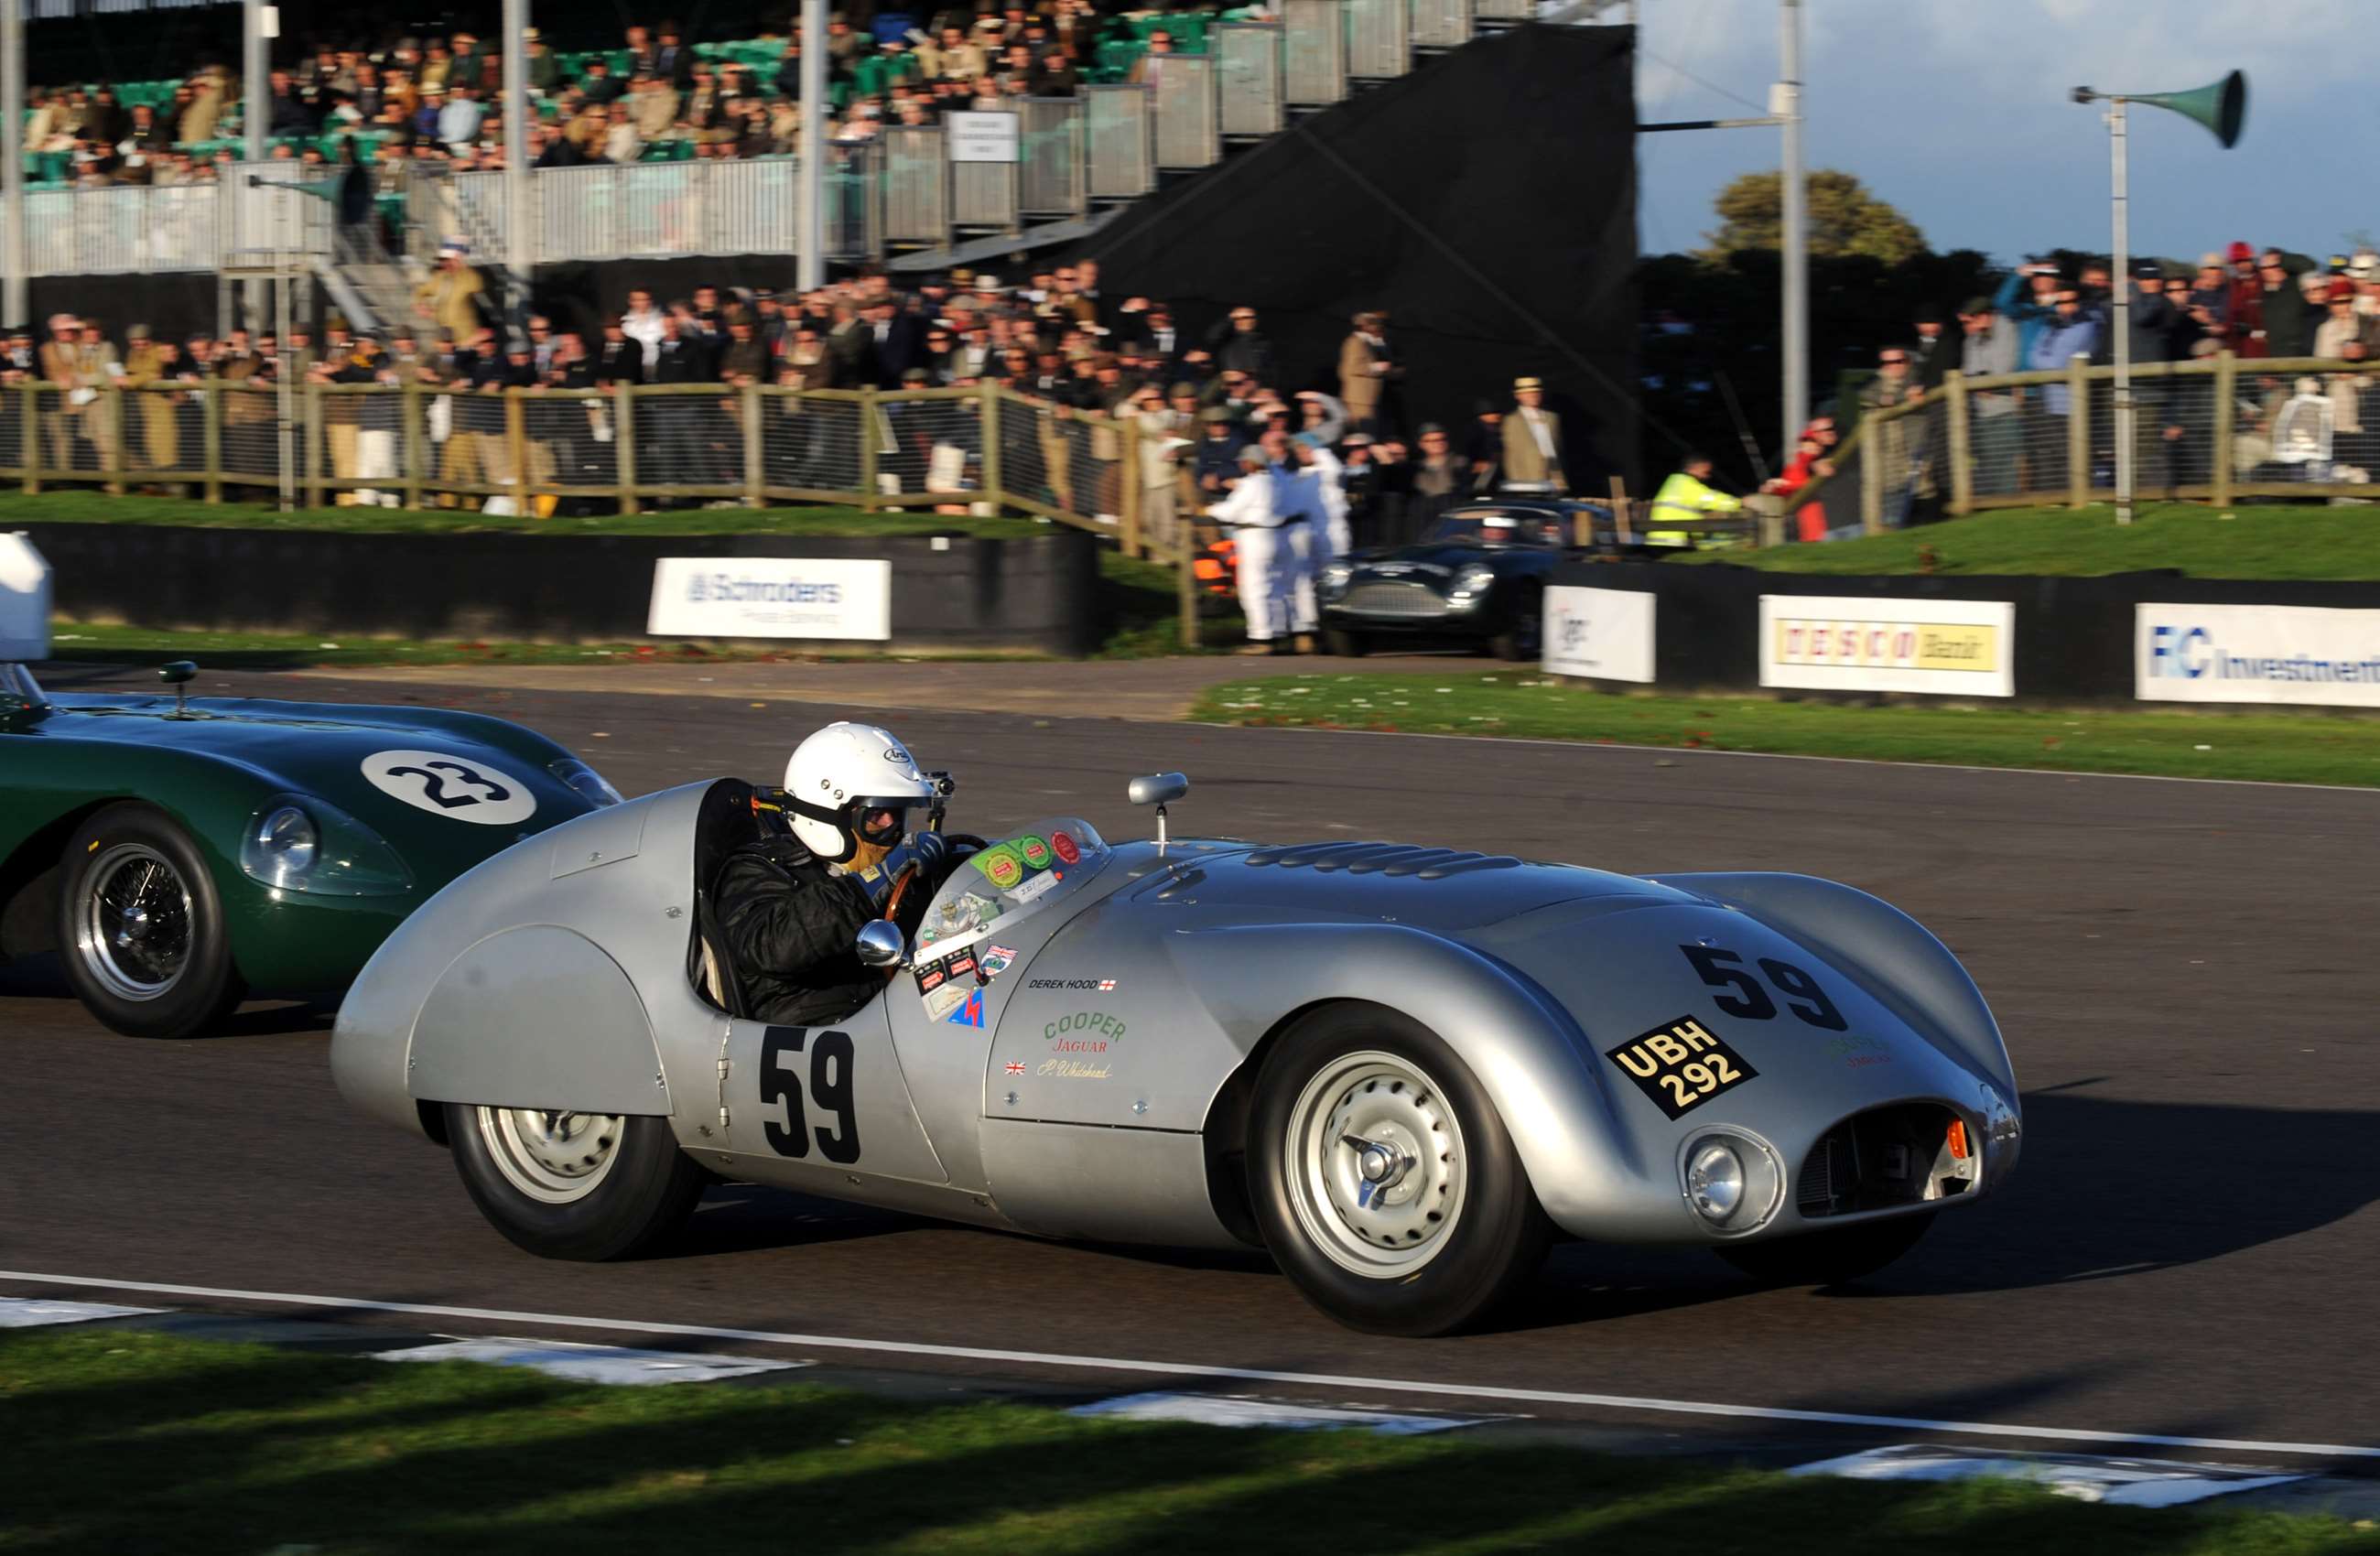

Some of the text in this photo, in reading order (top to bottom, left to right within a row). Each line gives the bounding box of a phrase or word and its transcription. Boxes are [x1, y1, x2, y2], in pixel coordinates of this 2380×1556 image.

[1786, 628, 1917, 660] TESCO
[385, 761, 511, 808] 23
[1028, 978, 1098, 989] DEREK HOOD
[1679, 945, 1848, 1032] 59
[1044, 1011, 1127, 1043] COOPER
[1053, 1037, 1108, 1054] JAGUAR
[1616, 1021, 1718, 1078] UBH
[760, 1025, 861, 1165] 59
[1660, 1054, 1742, 1108] 292
